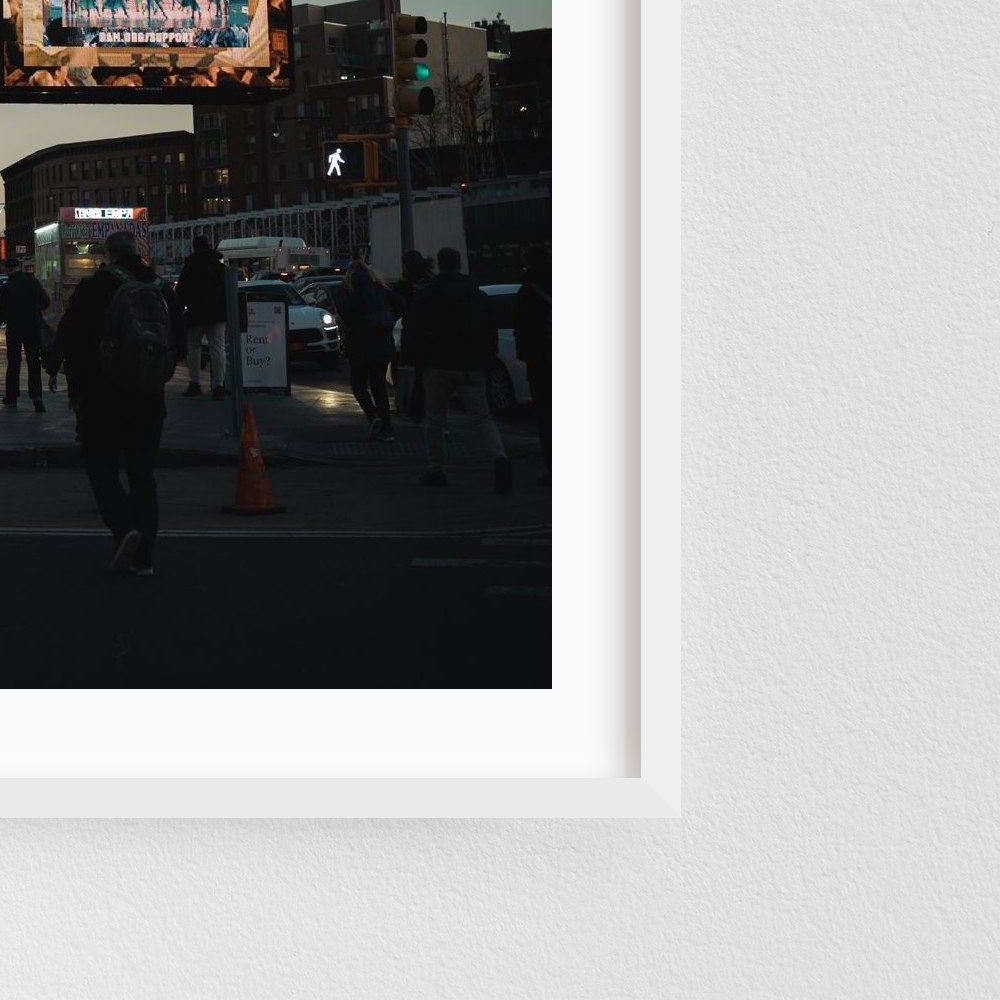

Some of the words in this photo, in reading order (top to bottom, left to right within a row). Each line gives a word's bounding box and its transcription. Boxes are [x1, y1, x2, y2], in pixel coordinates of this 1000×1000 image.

[98, 31, 195, 43] BAM.ORG/SUPPORT
[246, 335, 268, 344] Rent
[247, 357, 270, 368] Buy?
